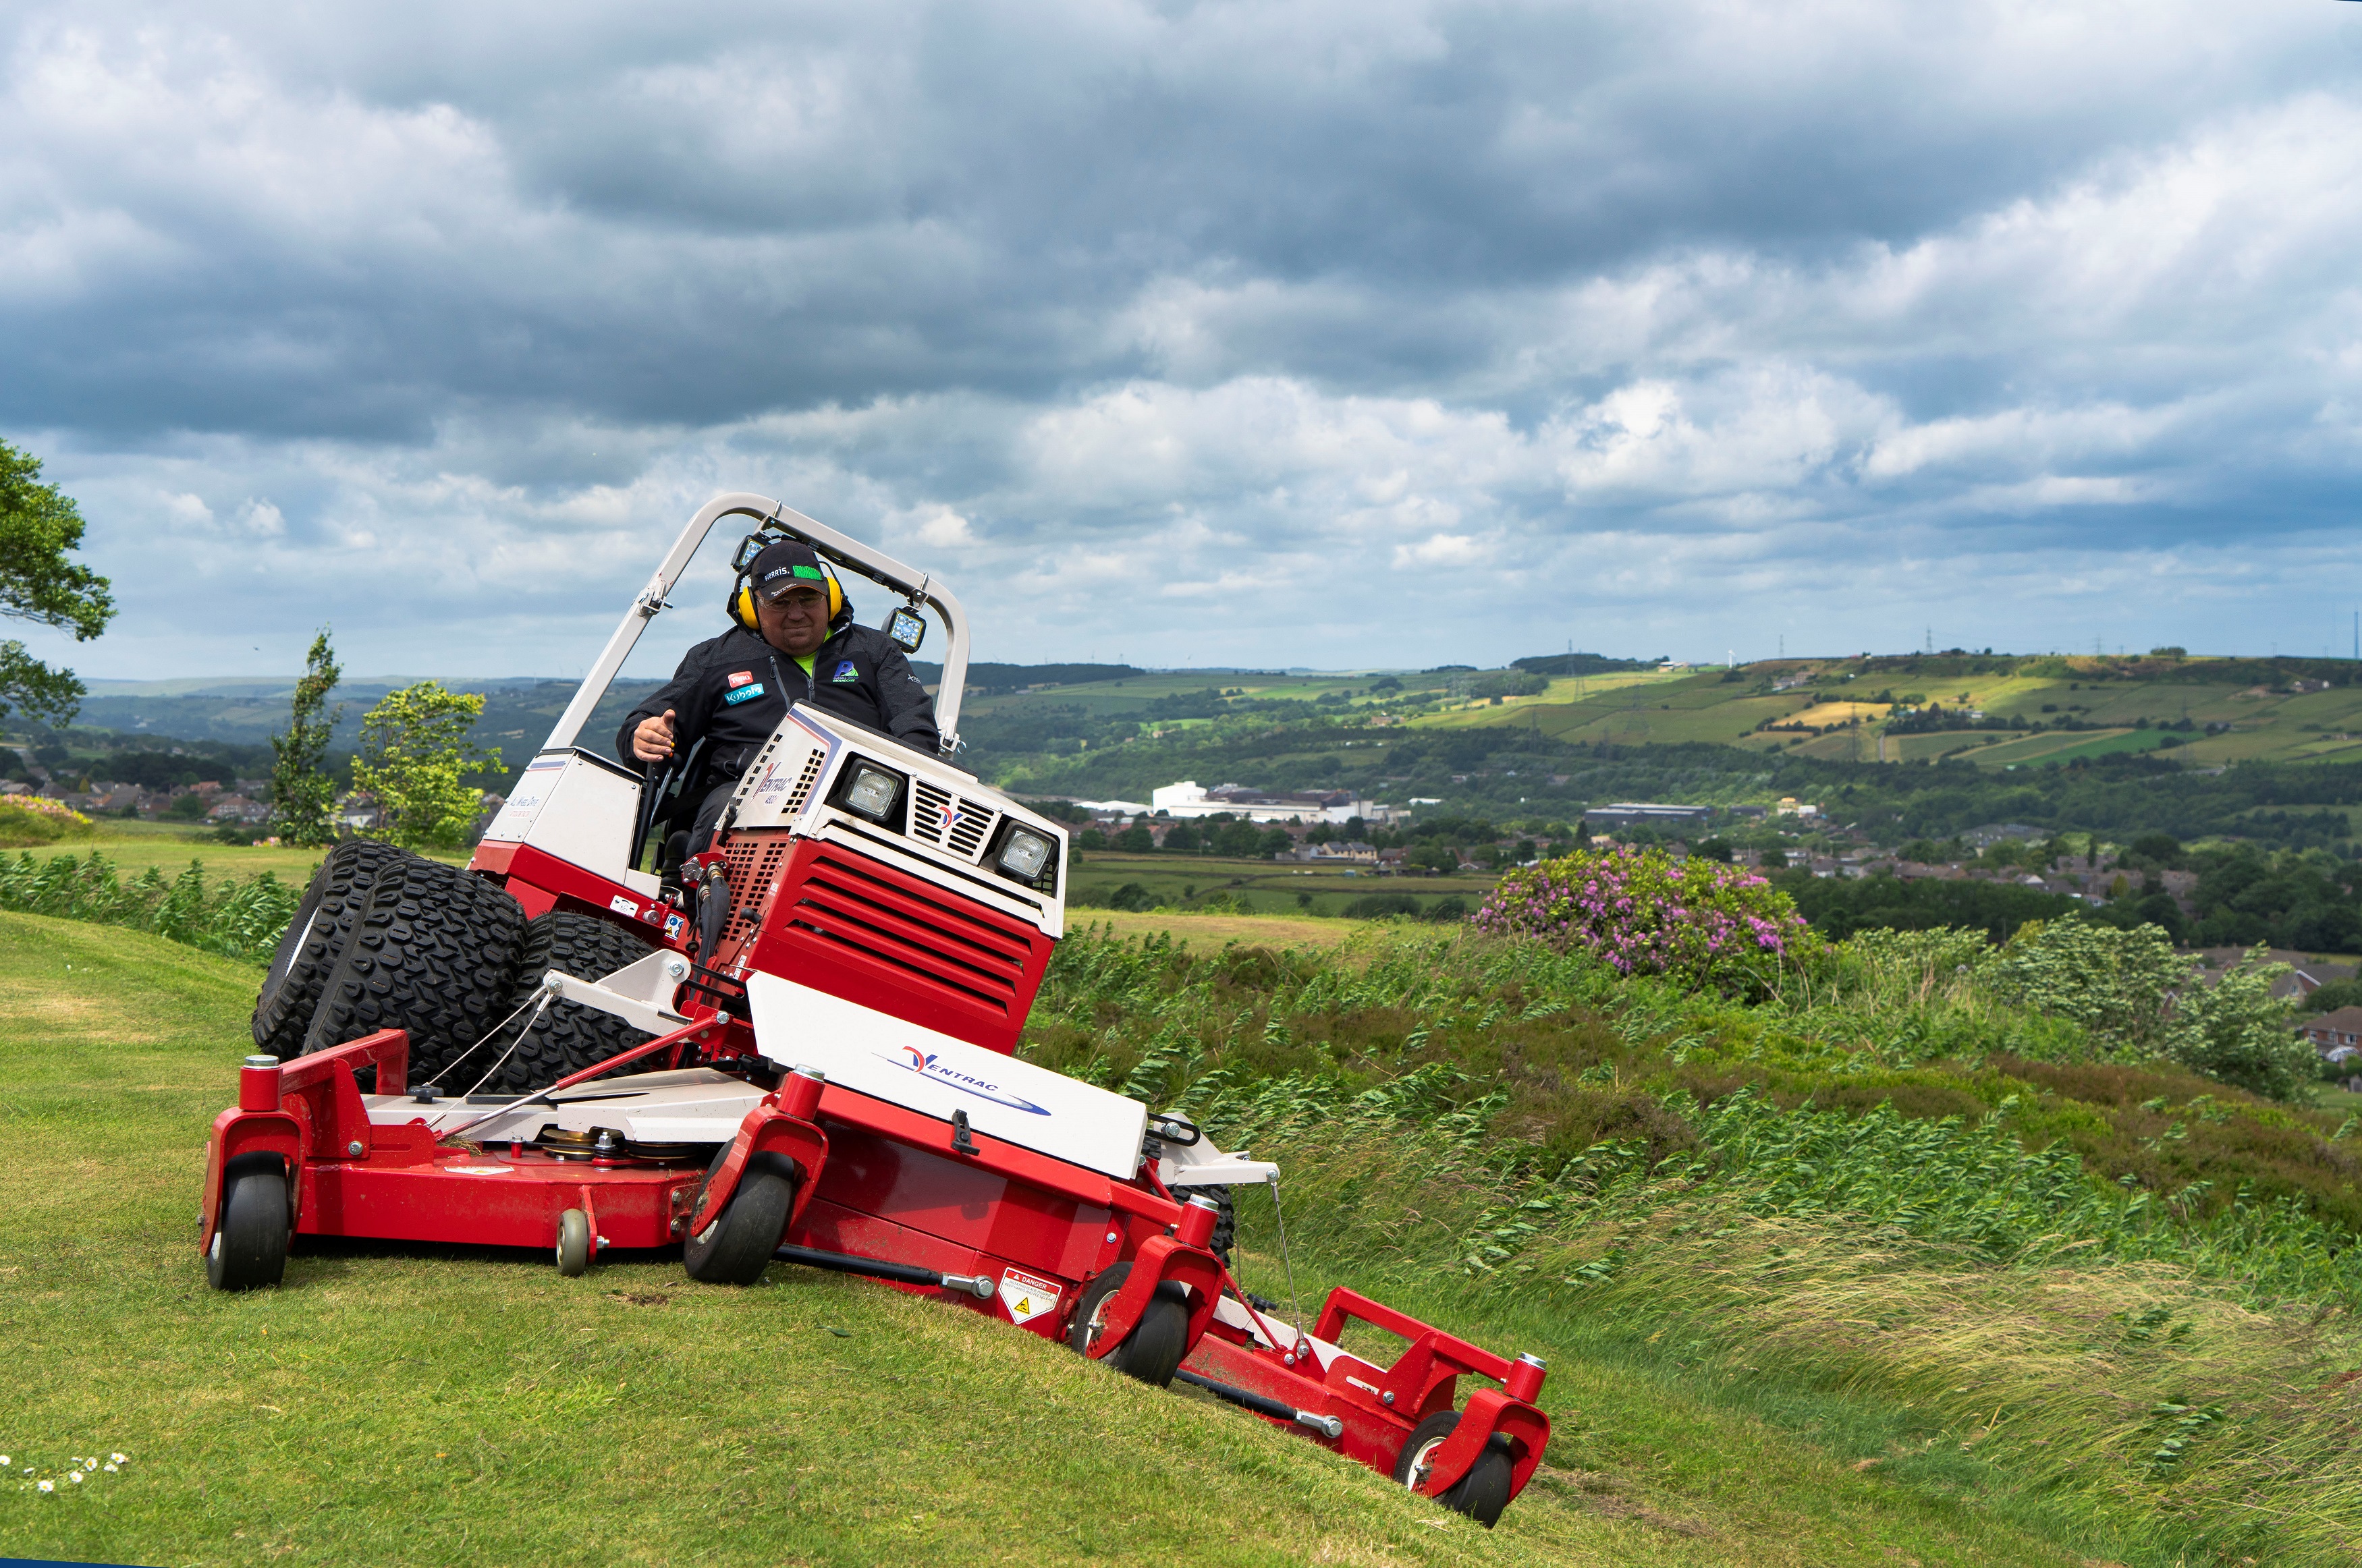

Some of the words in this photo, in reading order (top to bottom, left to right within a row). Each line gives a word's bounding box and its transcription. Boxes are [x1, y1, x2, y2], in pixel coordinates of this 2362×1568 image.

[730, 675, 751, 683] TORO
[726, 686, 762, 702] Kubota
[902, 1045, 999, 1091] VENTRAC
[1010, 1281, 1026, 1289] ROTATING
[1037, 1289, 1052, 1297] HAZARD
[1022, 1277, 1047, 1290] DANGER
